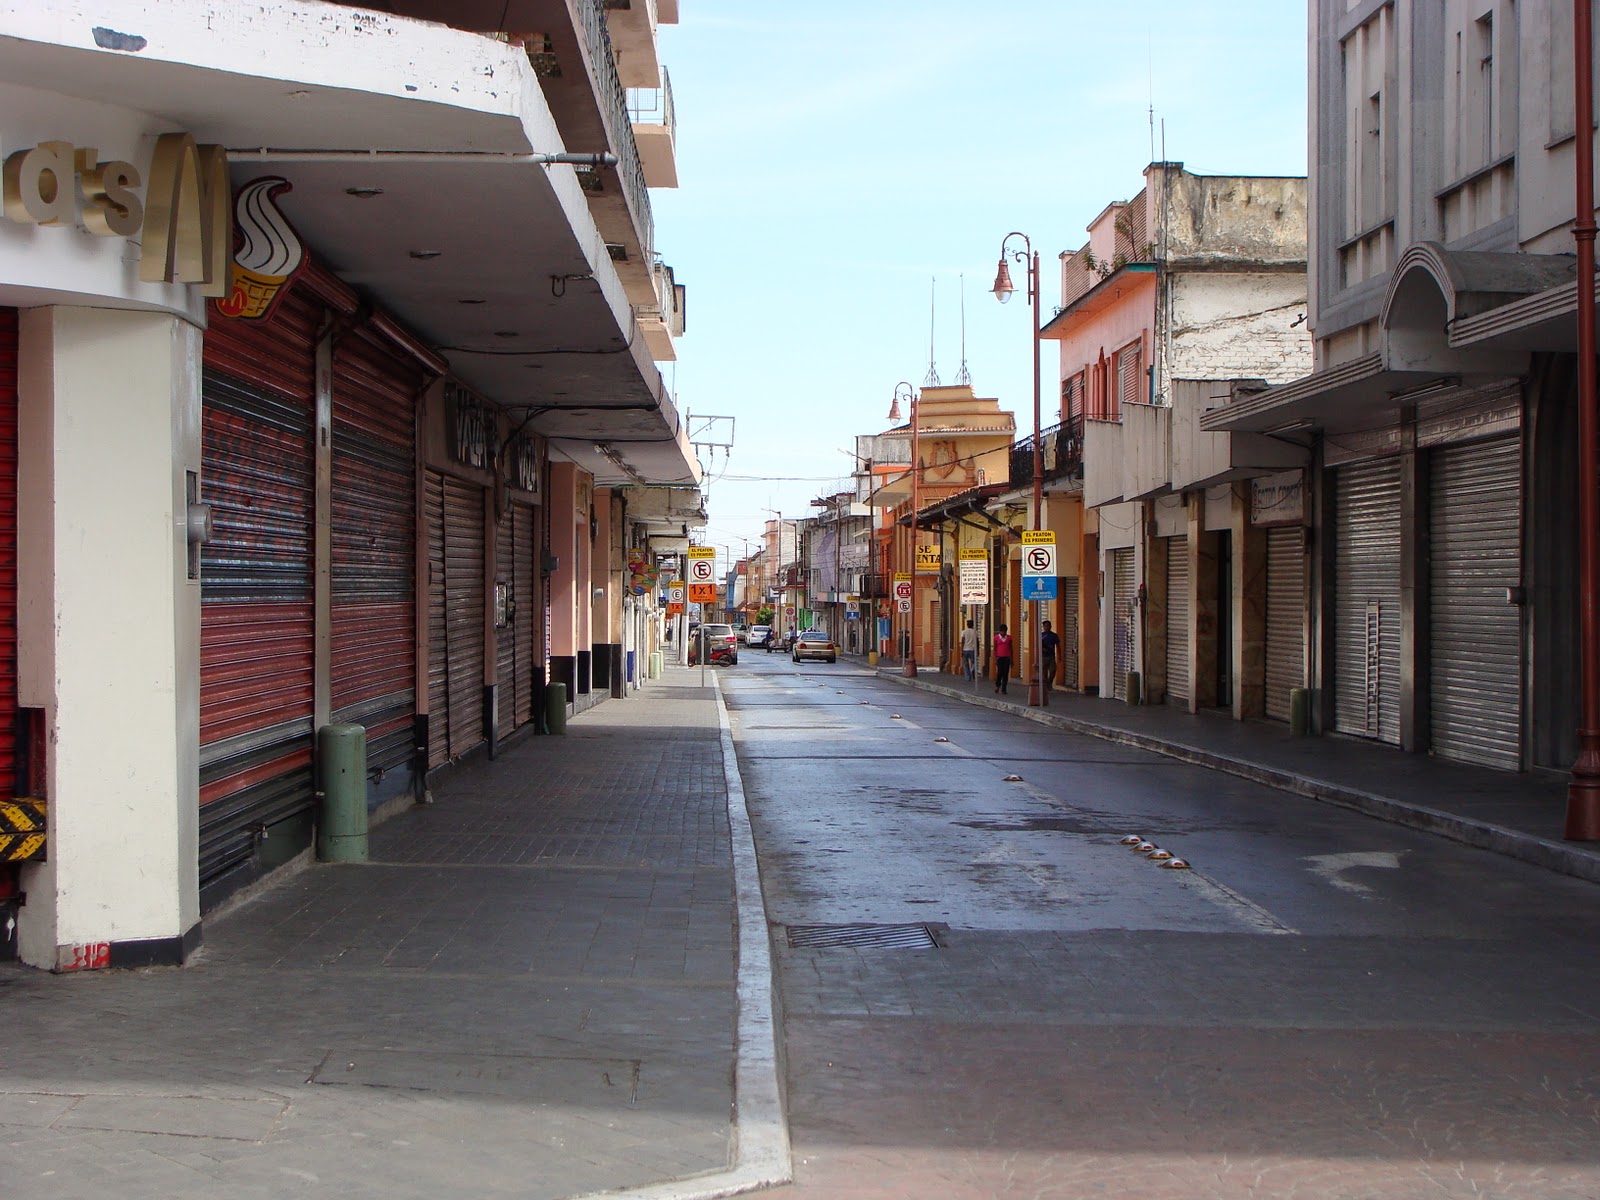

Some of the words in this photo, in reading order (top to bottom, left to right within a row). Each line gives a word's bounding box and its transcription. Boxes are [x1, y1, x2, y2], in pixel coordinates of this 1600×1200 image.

[918, 546, 932, 554] SE
[916, 555, 940, 563] ENTA
[1034, 552, 1044, 566] E
[698, 564, 706, 575] E
